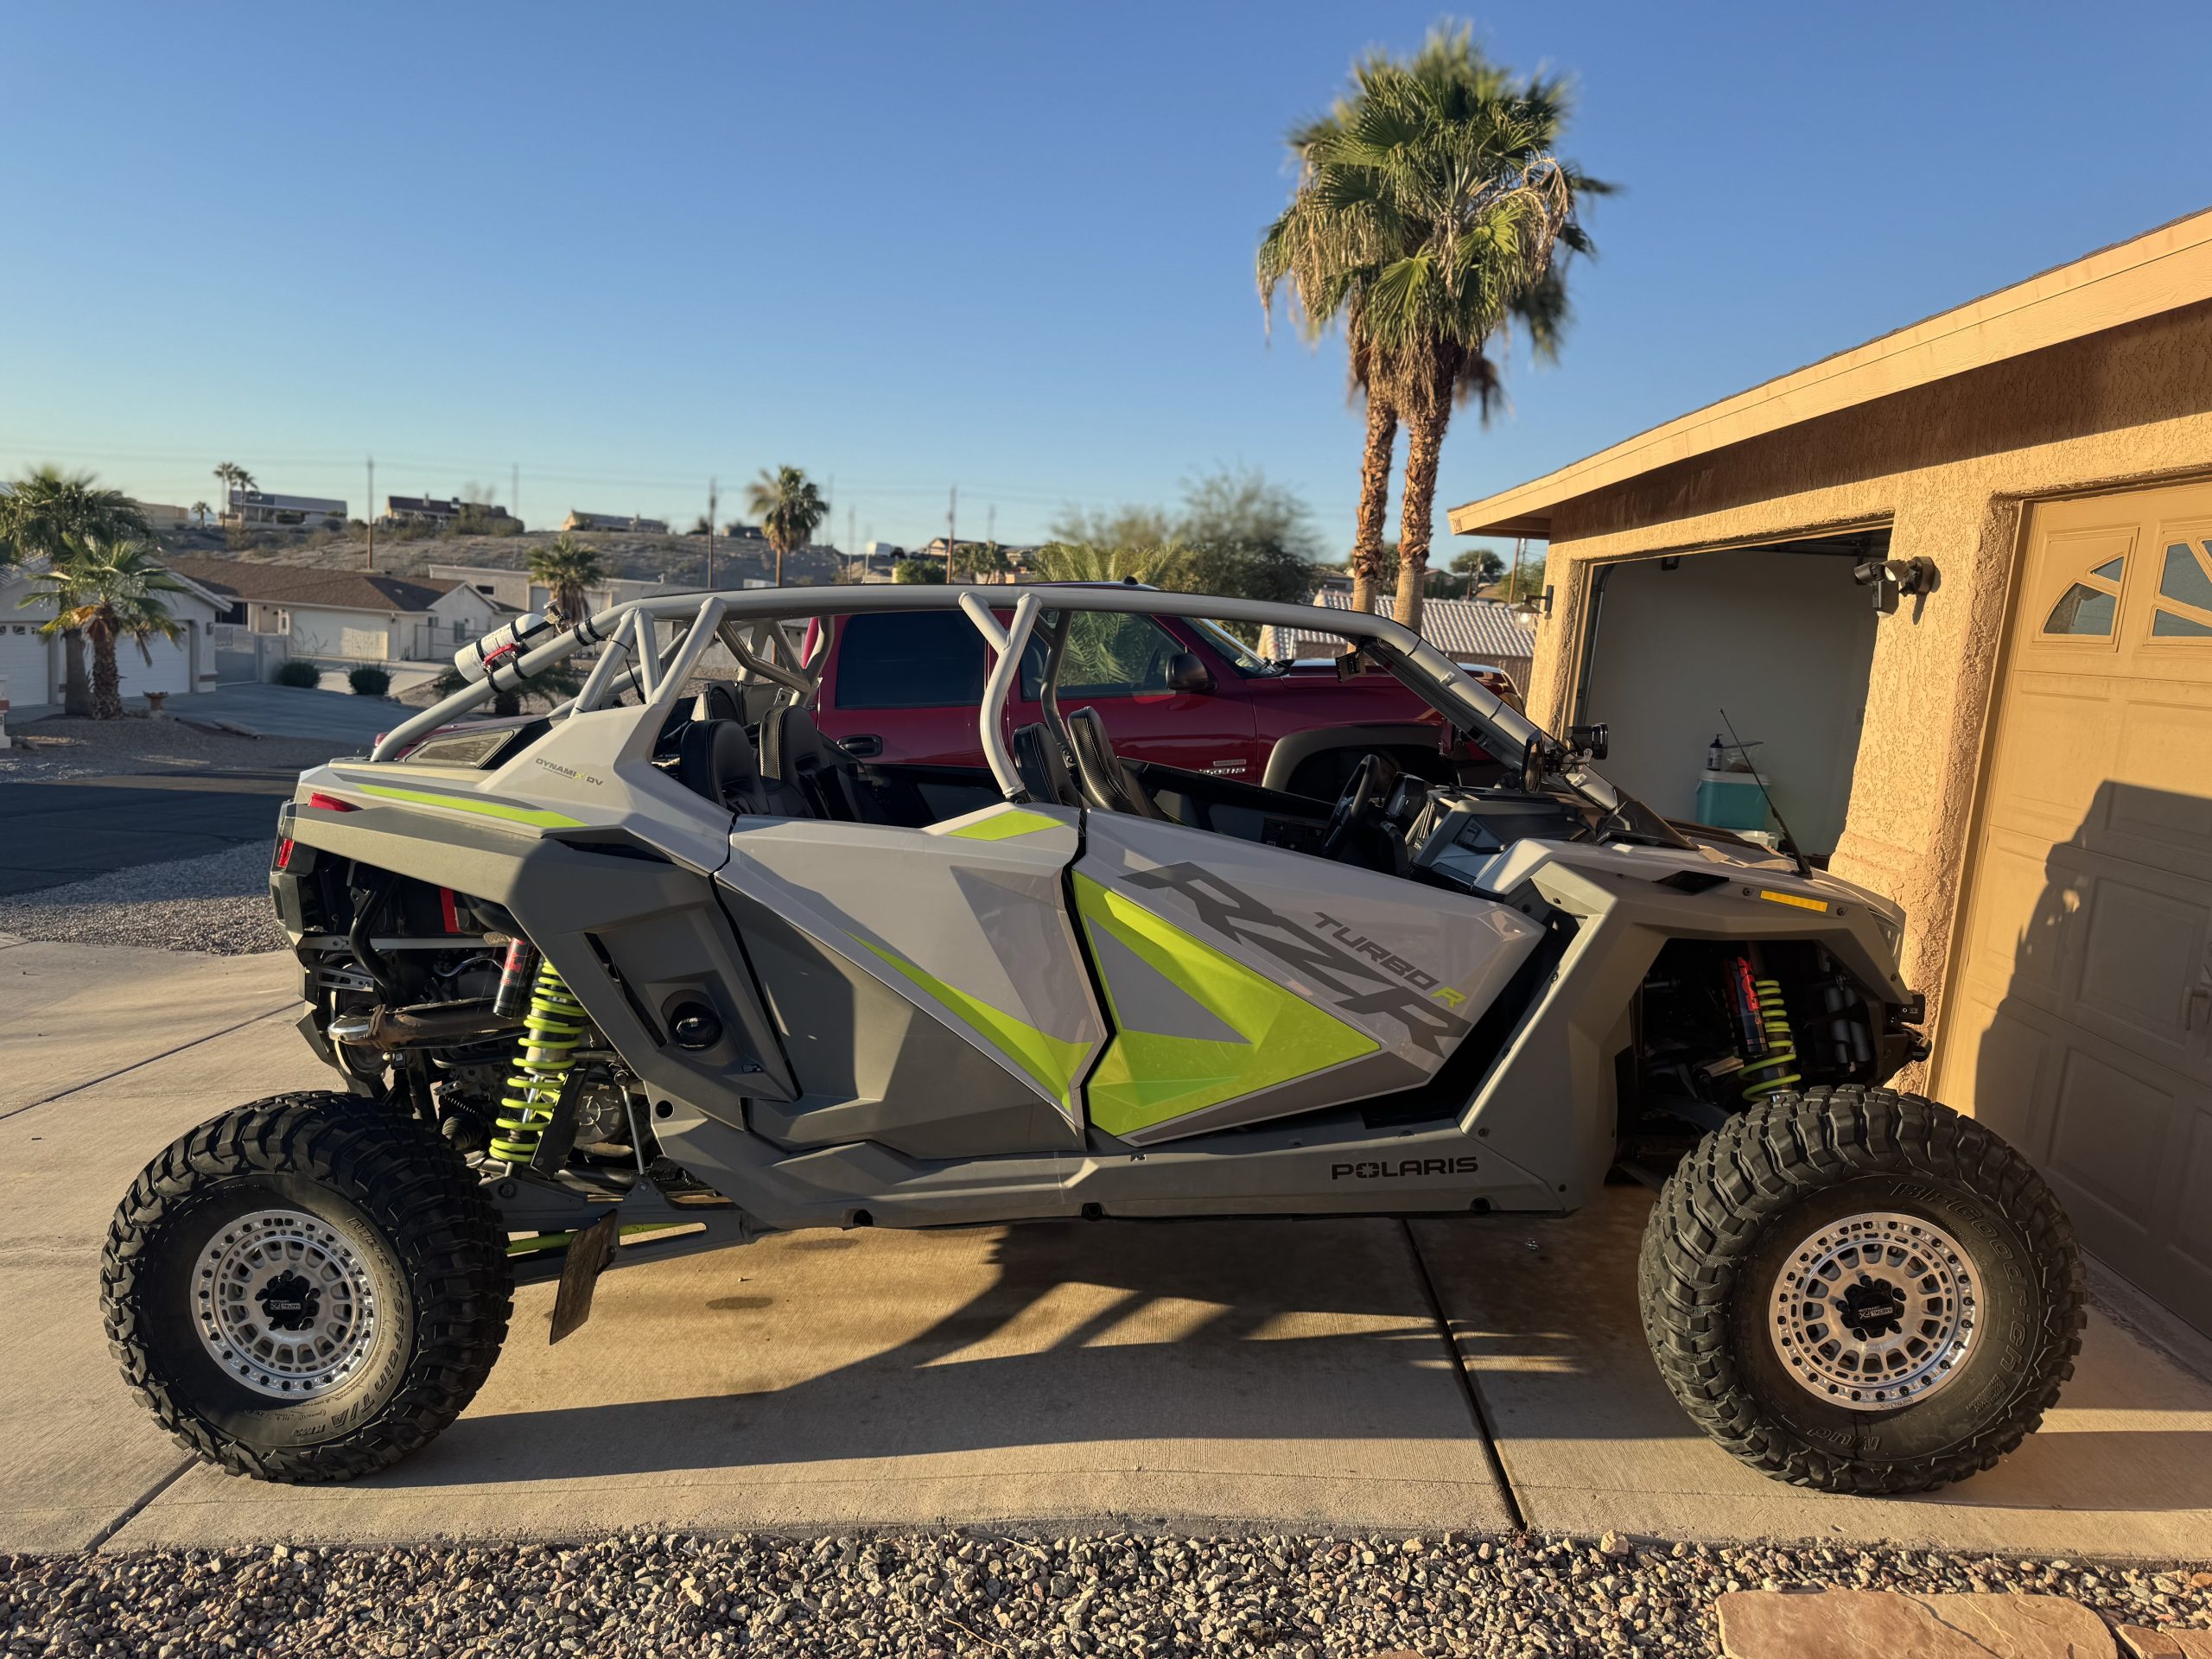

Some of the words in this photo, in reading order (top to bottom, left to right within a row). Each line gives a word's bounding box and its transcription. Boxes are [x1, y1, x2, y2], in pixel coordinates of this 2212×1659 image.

[535, 757, 586, 780] DYNAMIX
[586, 776, 604, 786] DV
[1118, 861, 1472, 1058] RZR
[1313, 912, 1440, 991] TURBO
[1431, 986, 1467, 1009] R
[1331, 1156, 1479, 1180] POLARIS
[331, 1392, 375, 1428] T/A
